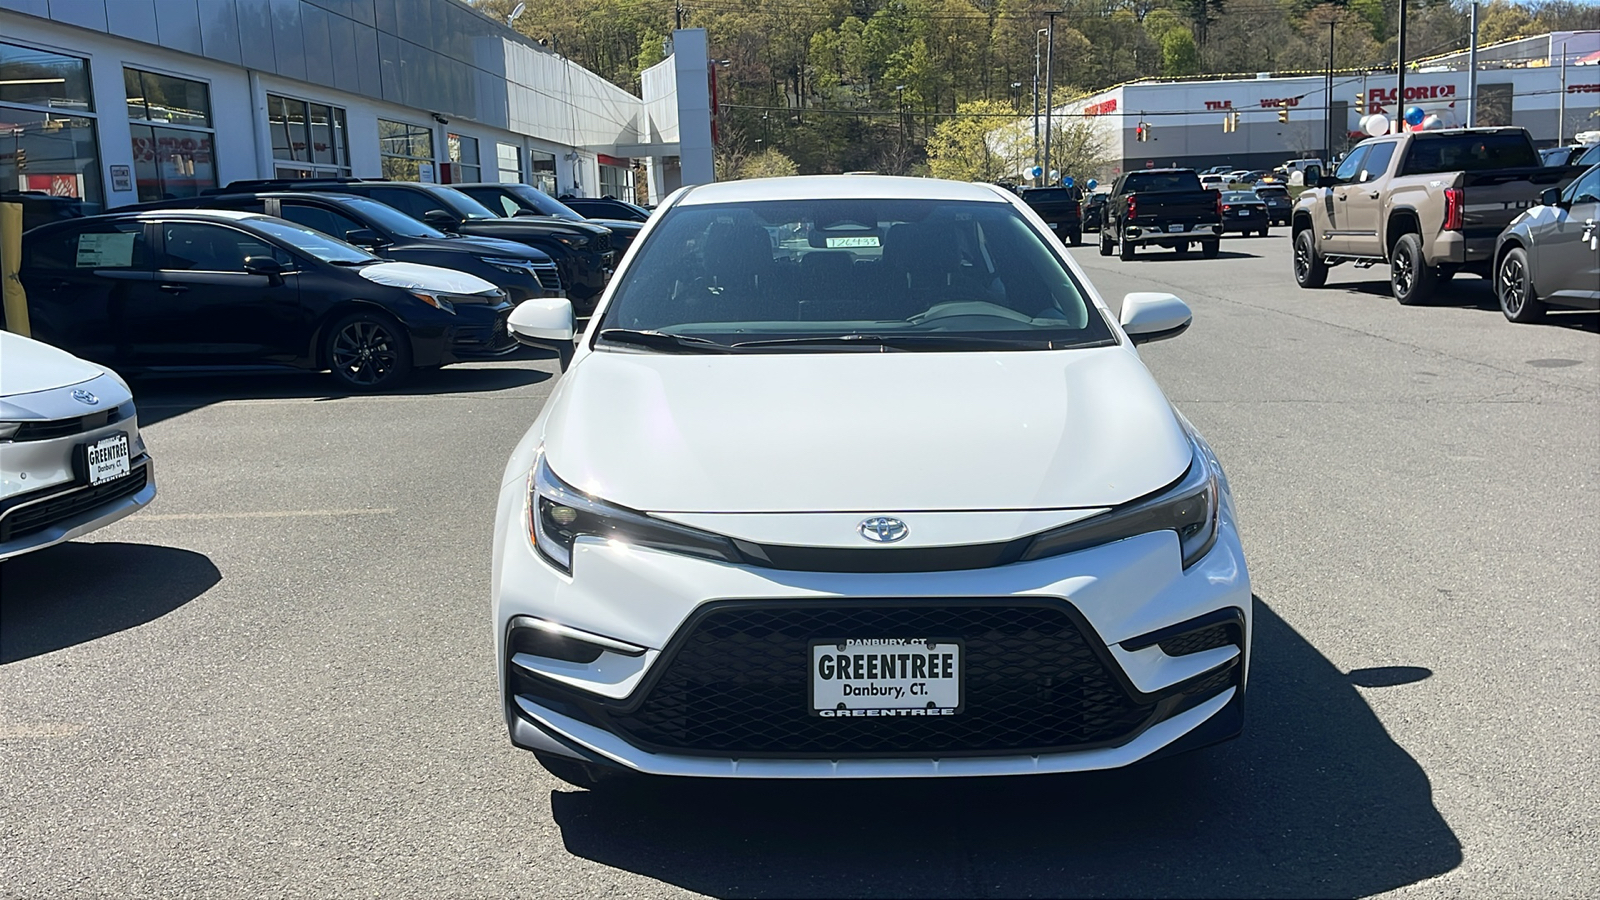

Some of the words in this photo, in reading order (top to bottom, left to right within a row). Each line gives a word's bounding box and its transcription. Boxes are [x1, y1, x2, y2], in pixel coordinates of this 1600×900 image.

[1369, 86, 1429, 102] FLOOR
[1205, 100, 1232, 110] TILE
[89, 442, 127, 466] GREENTREE
[818, 653, 954, 680] GREENTREE
[843, 682, 906, 699] Danbury,
[909, 682, 929, 696] CT.
[819, 709, 955, 717] GREENTREE
